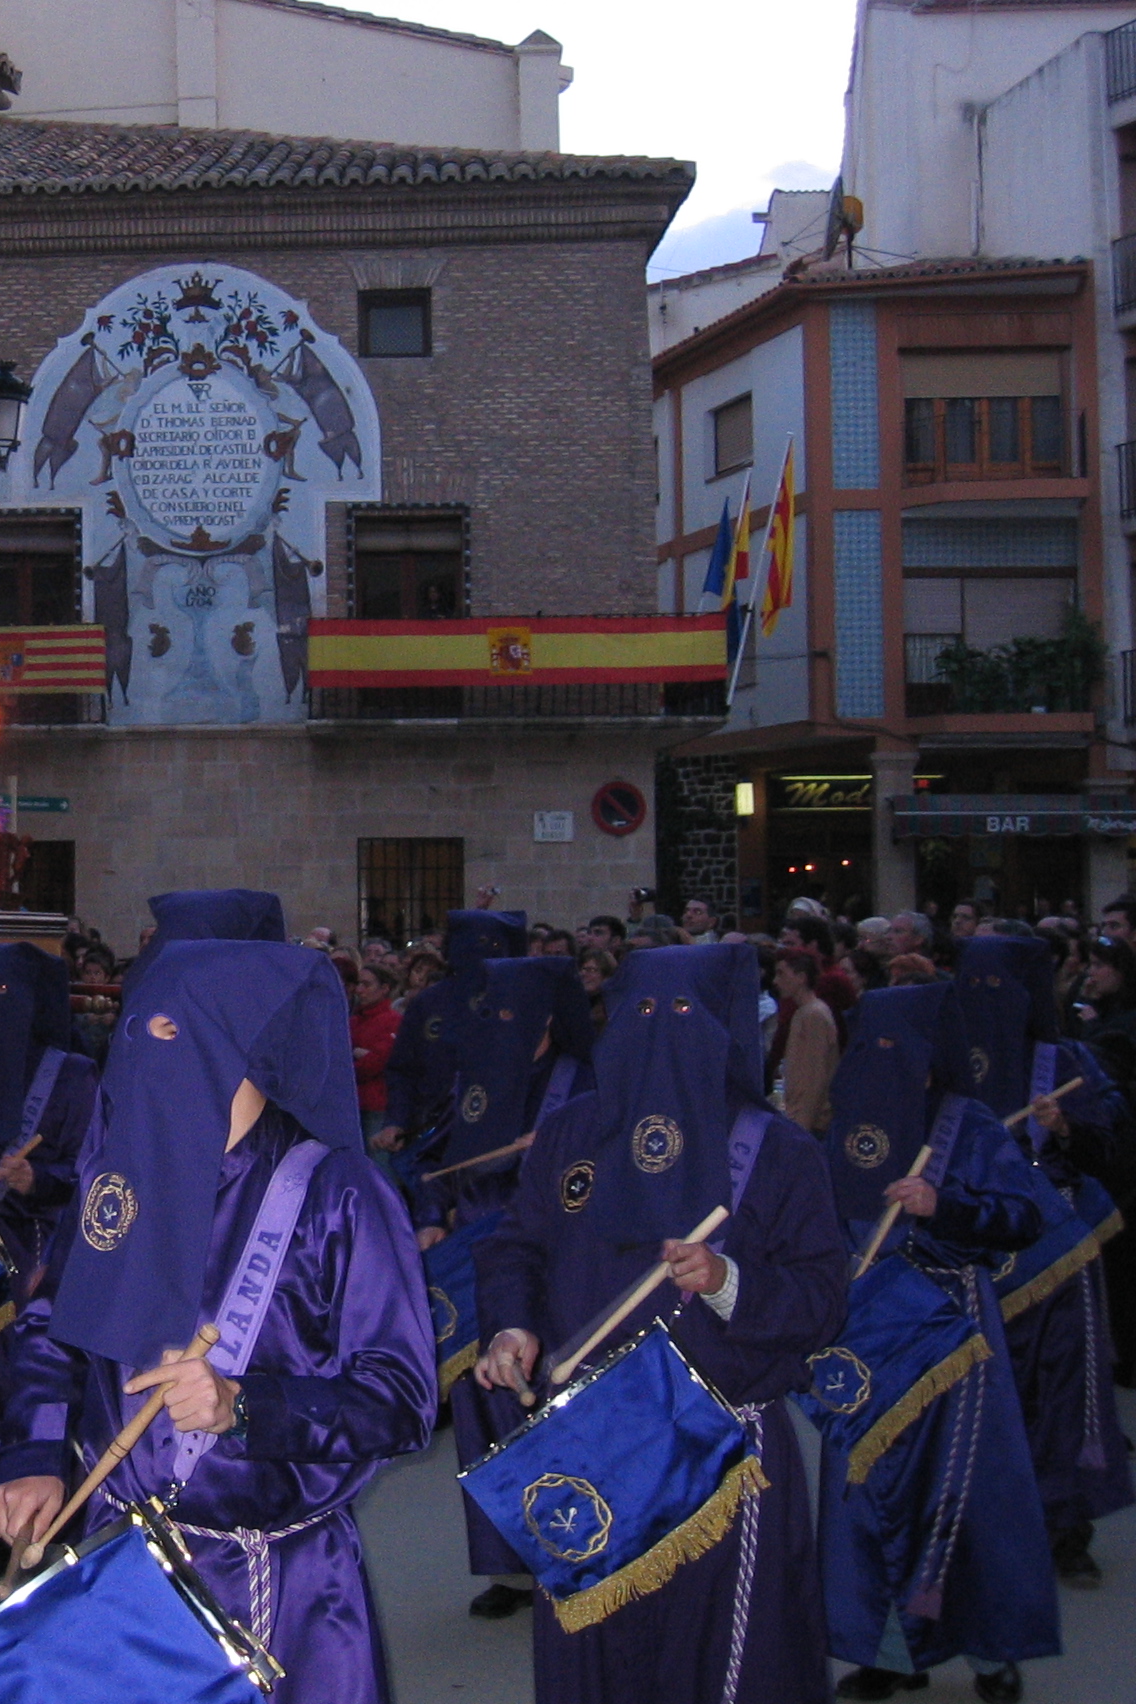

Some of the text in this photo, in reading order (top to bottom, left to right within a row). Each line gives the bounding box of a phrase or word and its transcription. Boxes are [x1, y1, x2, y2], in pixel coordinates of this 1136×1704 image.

[154, 403, 168, 414] EL
[209, 400, 247, 413] SEÑOR
[158, 416, 205, 428] THOMAS
[211, 415, 257, 427] BERNAD
[138, 430, 200, 443] SECRETARIO
[203, 472, 260, 483] ALCALDE
[143, 488, 159, 499] DE
[163, 487, 199, 499] CASA
[213, 487, 253, 498] CORTE
[185, 584, 215, 597] AÑO
[986, 816, 1029, 832] BAR
